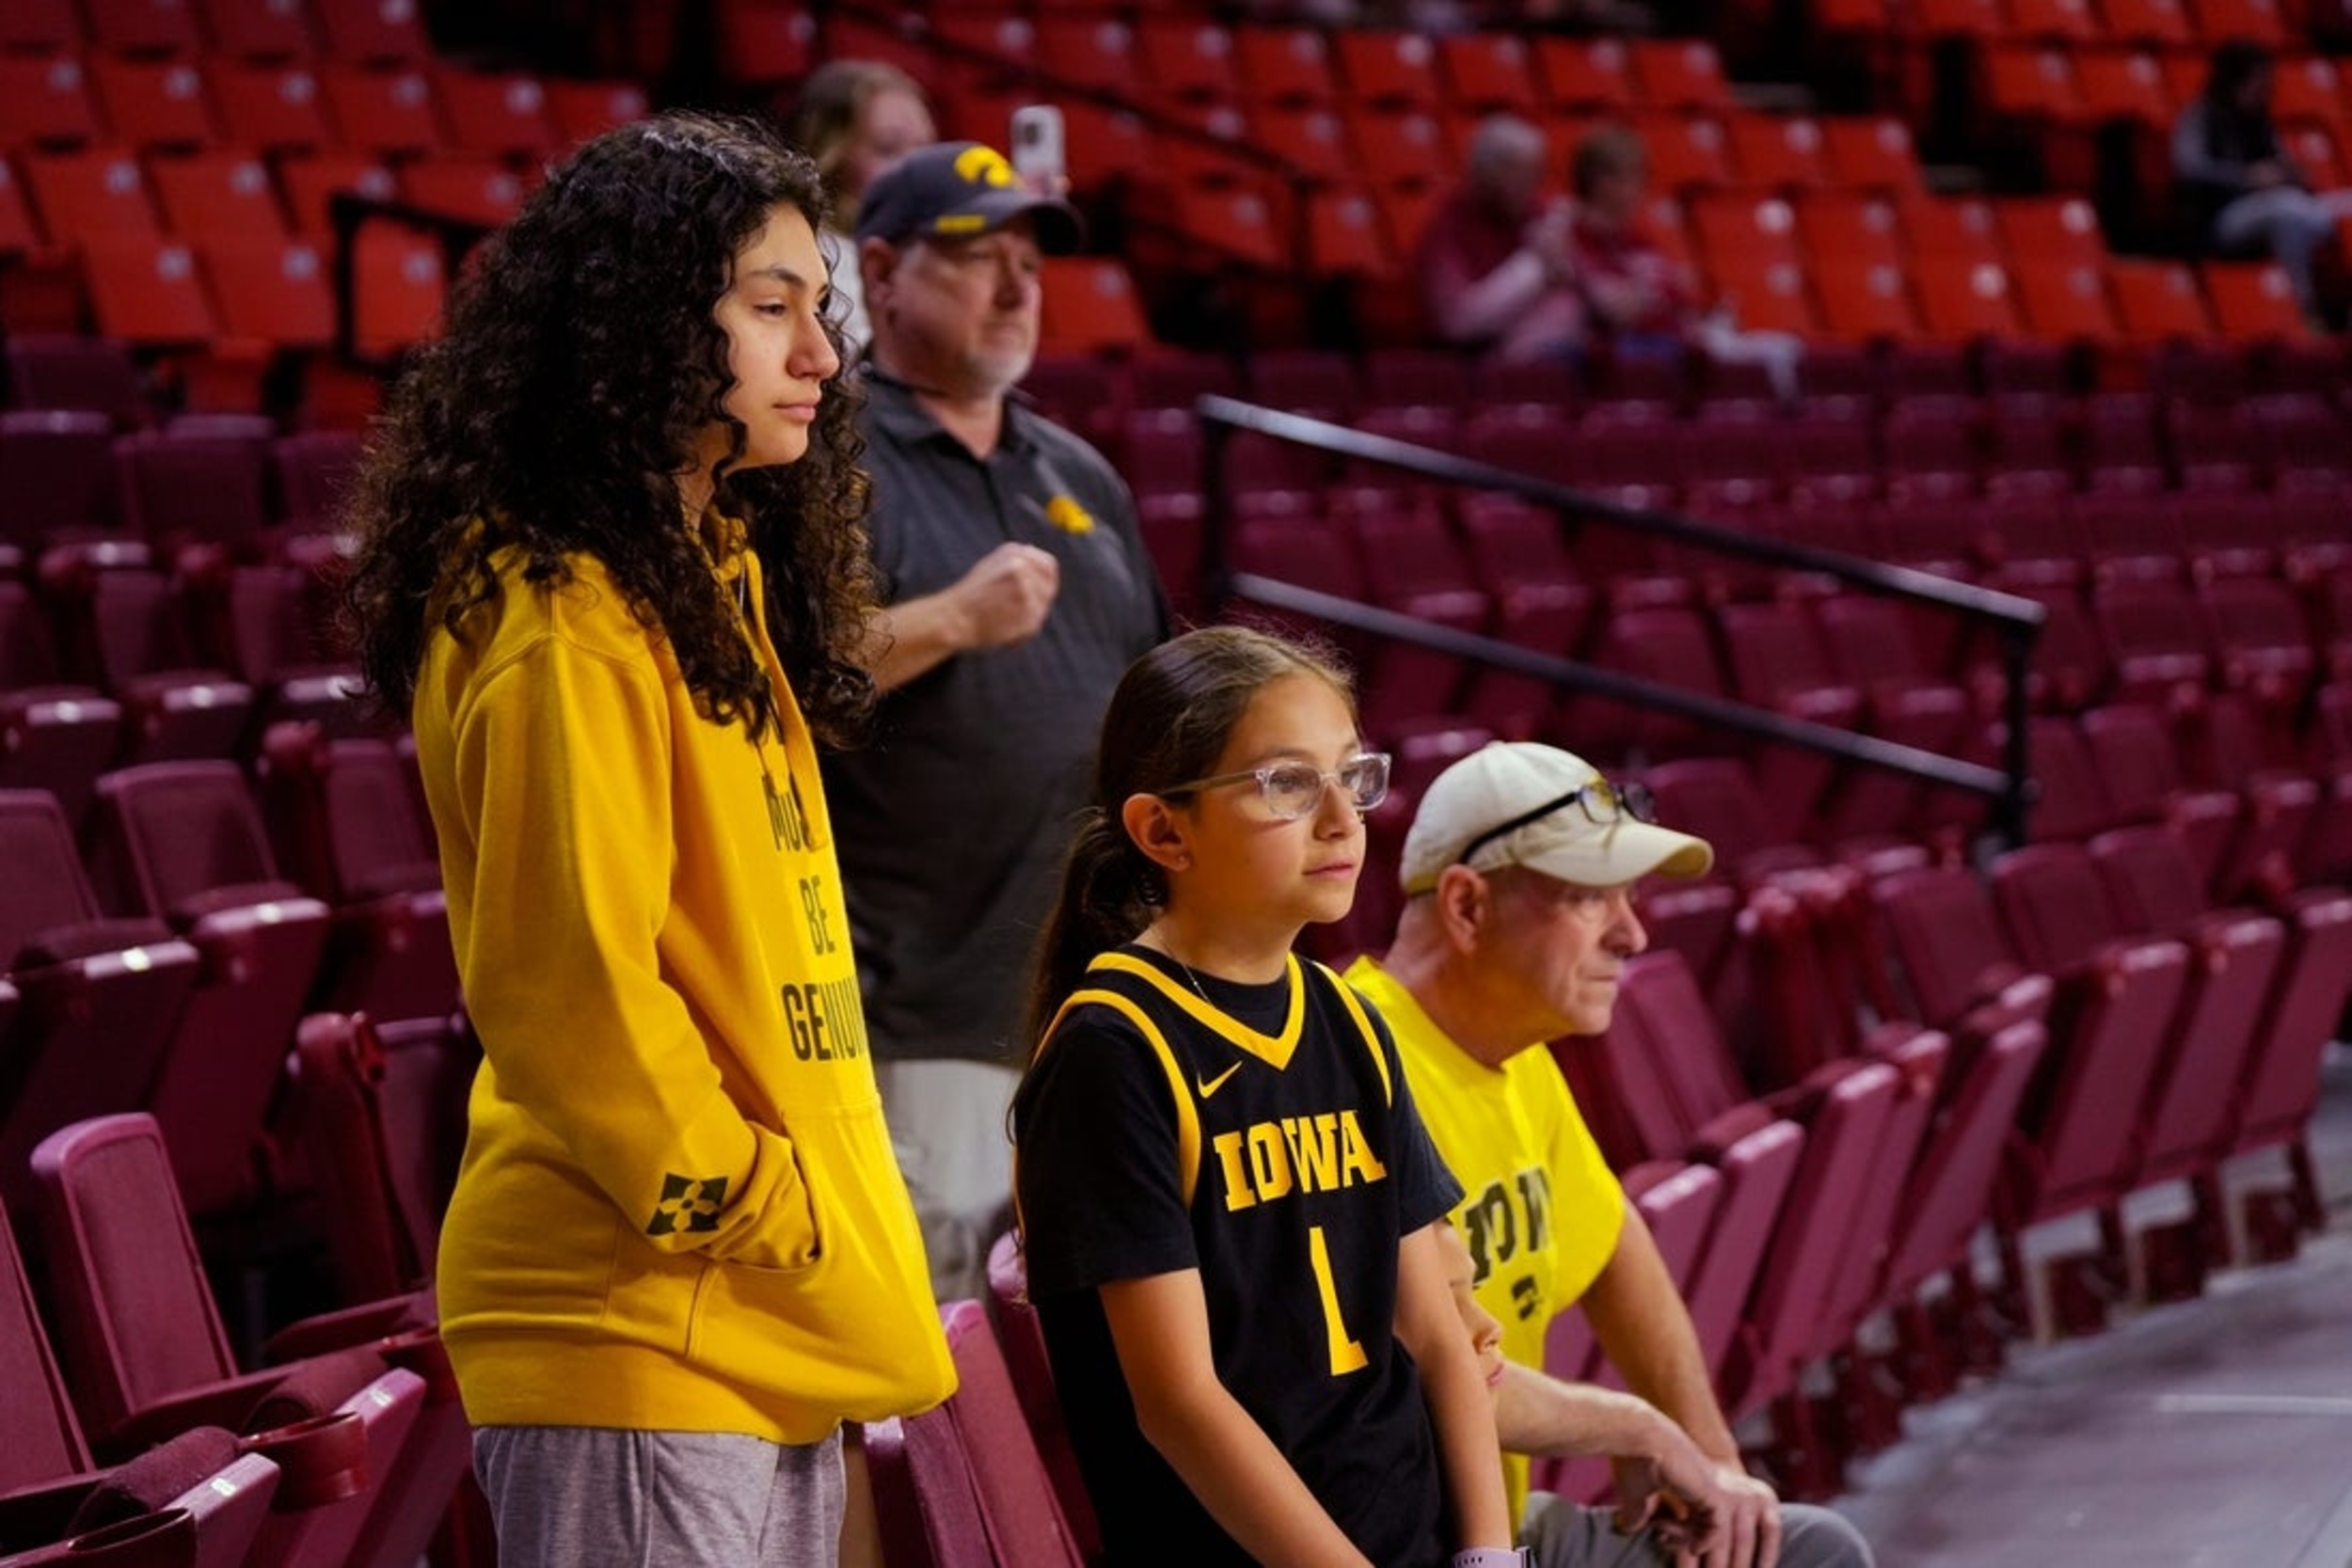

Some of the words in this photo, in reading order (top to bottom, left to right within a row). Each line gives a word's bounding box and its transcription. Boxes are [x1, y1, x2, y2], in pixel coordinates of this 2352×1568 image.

[799, 875, 835, 955] BE
[1214, 1110, 1387, 1212] IOWA
[1310, 1227, 1368, 1376] 1
